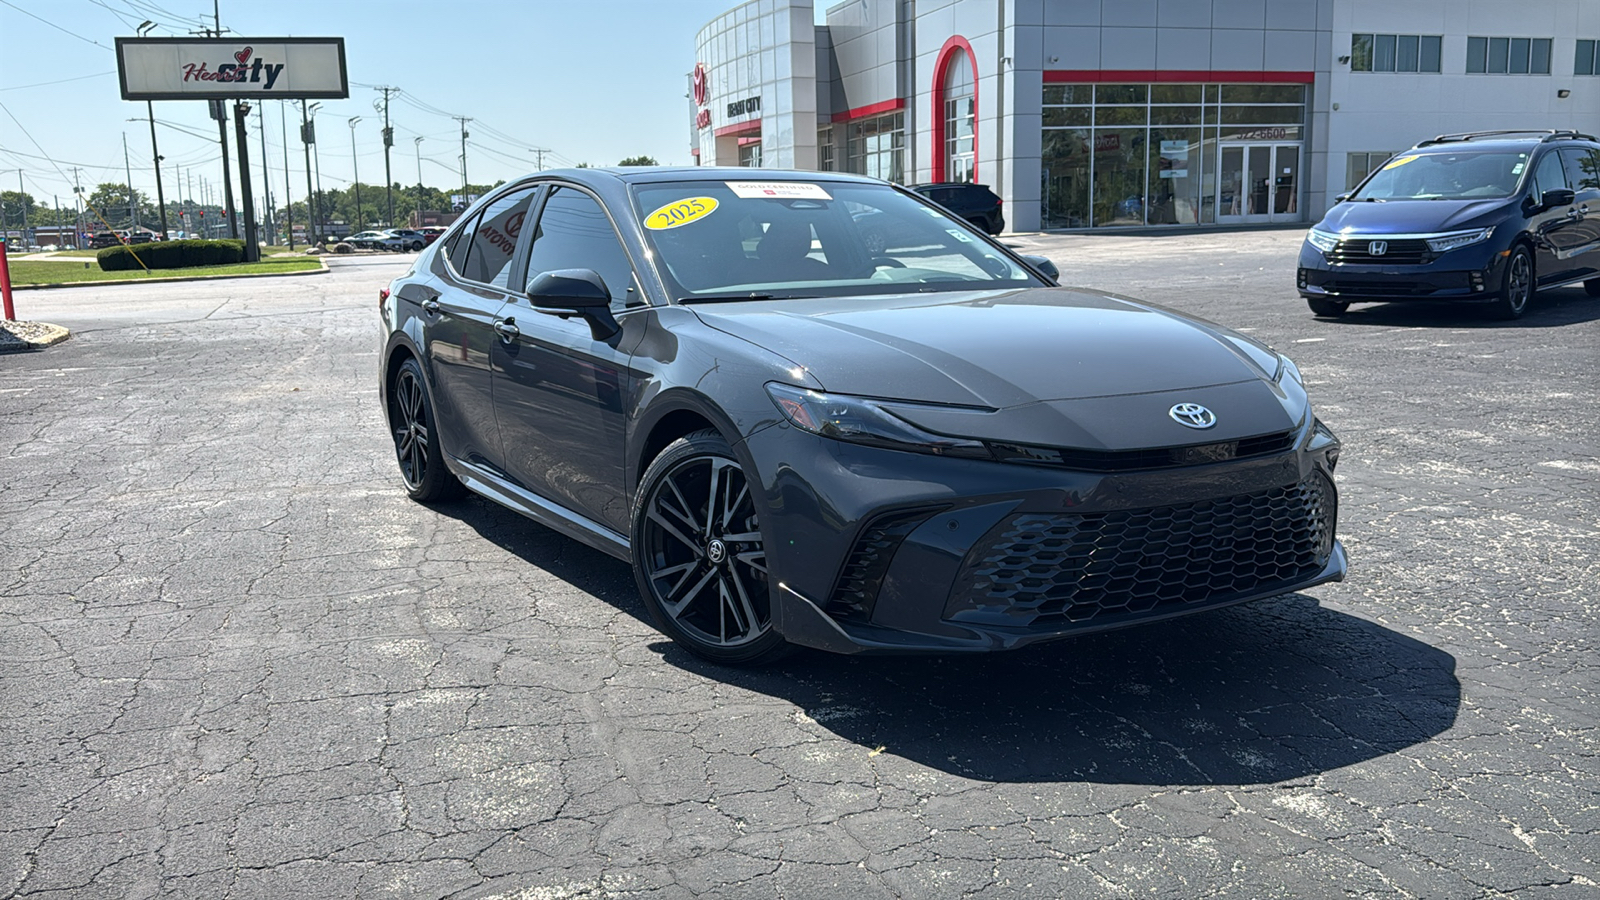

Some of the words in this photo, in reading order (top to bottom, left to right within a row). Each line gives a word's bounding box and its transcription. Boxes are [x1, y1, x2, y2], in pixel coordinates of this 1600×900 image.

[182, 62, 253, 82] Heart
[746, 96, 761, 113] CITY
[658, 199, 705, 226] 2025
